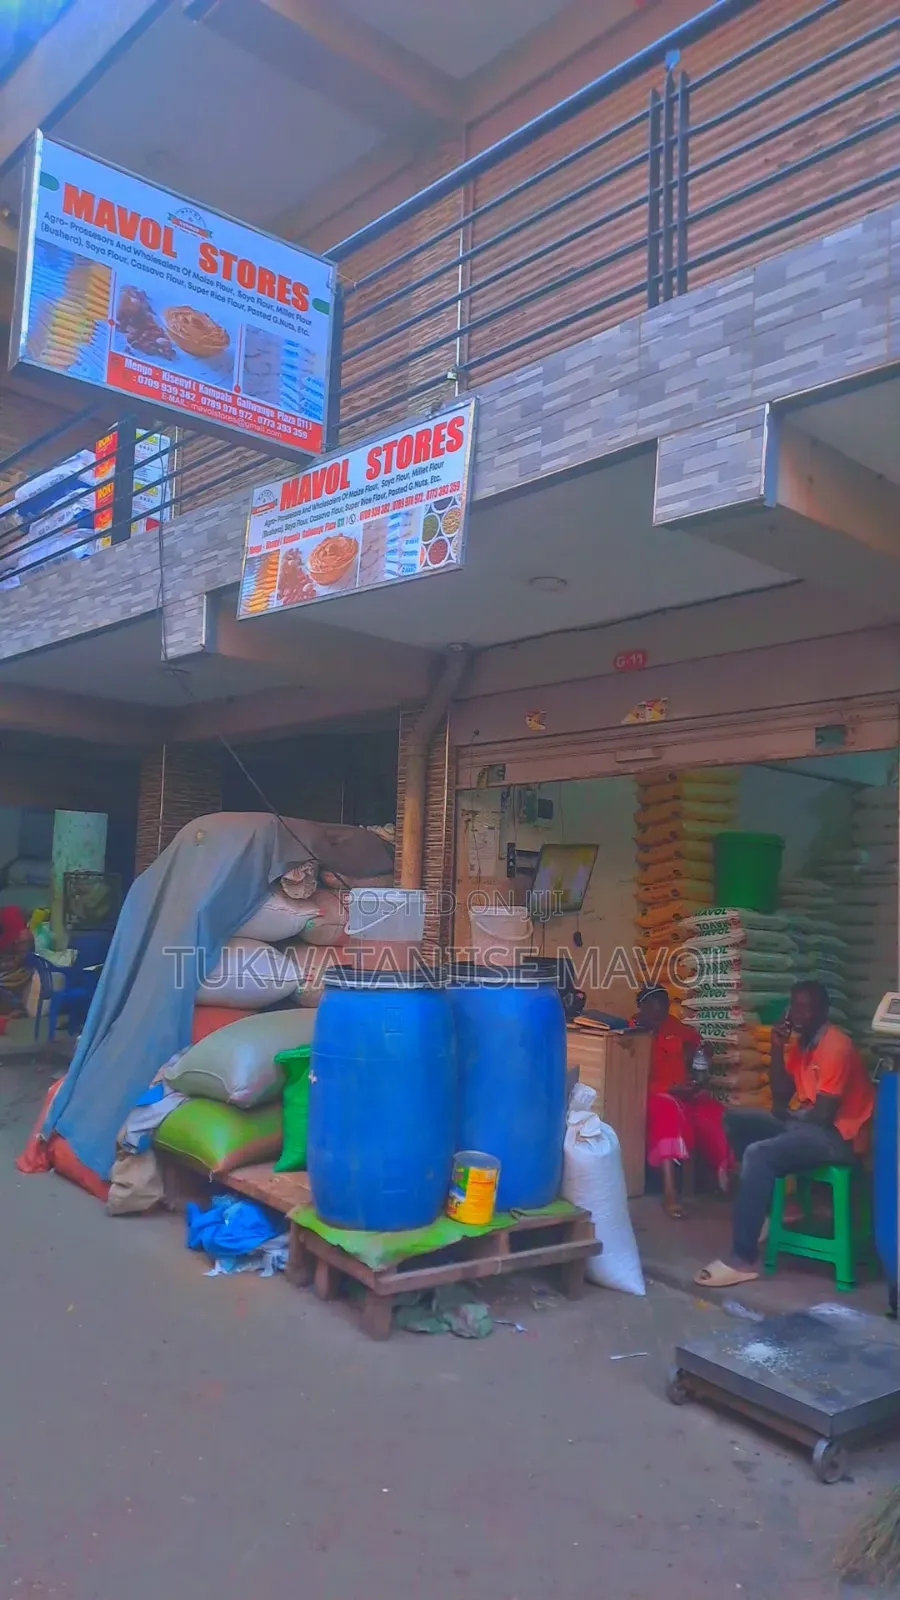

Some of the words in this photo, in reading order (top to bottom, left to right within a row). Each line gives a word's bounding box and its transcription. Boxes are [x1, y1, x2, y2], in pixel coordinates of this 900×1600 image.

[63, 181, 177, 259] MAVOL
[199, 242, 309, 312] STORES
[107, 249, 130, 266] Flour,
[131, 259, 164, 279] Cassava
[166, 272, 186, 288] Flour,
[187, 282, 209, 297] Super
[210, 290, 226, 304] Rice
[227, 297, 246, 313] Flour,
[247, 305, 271, 321] Pasted
[116, 240, 132, 253] And
[133, 247, 181, 273] Wholesalers
[181, 267, 191, 277] Of
[192, 271, 214, 287] Maize
[215, 280, 235, 296] Flour,
[256, 297, 275, 313] Flour,
[276, 305, 295, 320] Millet
[296, 313, 312, 326] Flour
[124, 358, 152, 376] Mengo
[199, 383, 232, 404] Kampala
[277, 410, 295, 426] Plaza
[137, 374, 159, 389] 0709
[161, 383, 178, 396] 939
[201, 396, 221, 411] 0789
[223, 404, 237, 416] 978
[239, 409, 253, 421] 972
[280, 458, 350, 511] MAVOL
[366, 415, 465, 480] STORES
[349, 488, 364, 499] Maize
[429, 461, 444, 472] Flour
[388, 485, 407, 497] Pasted
[616, 653, 644, 668] G-11
[696, 1011, 729, 1019] MAVOL
[700, 1029, 727, 1038] AVOL
